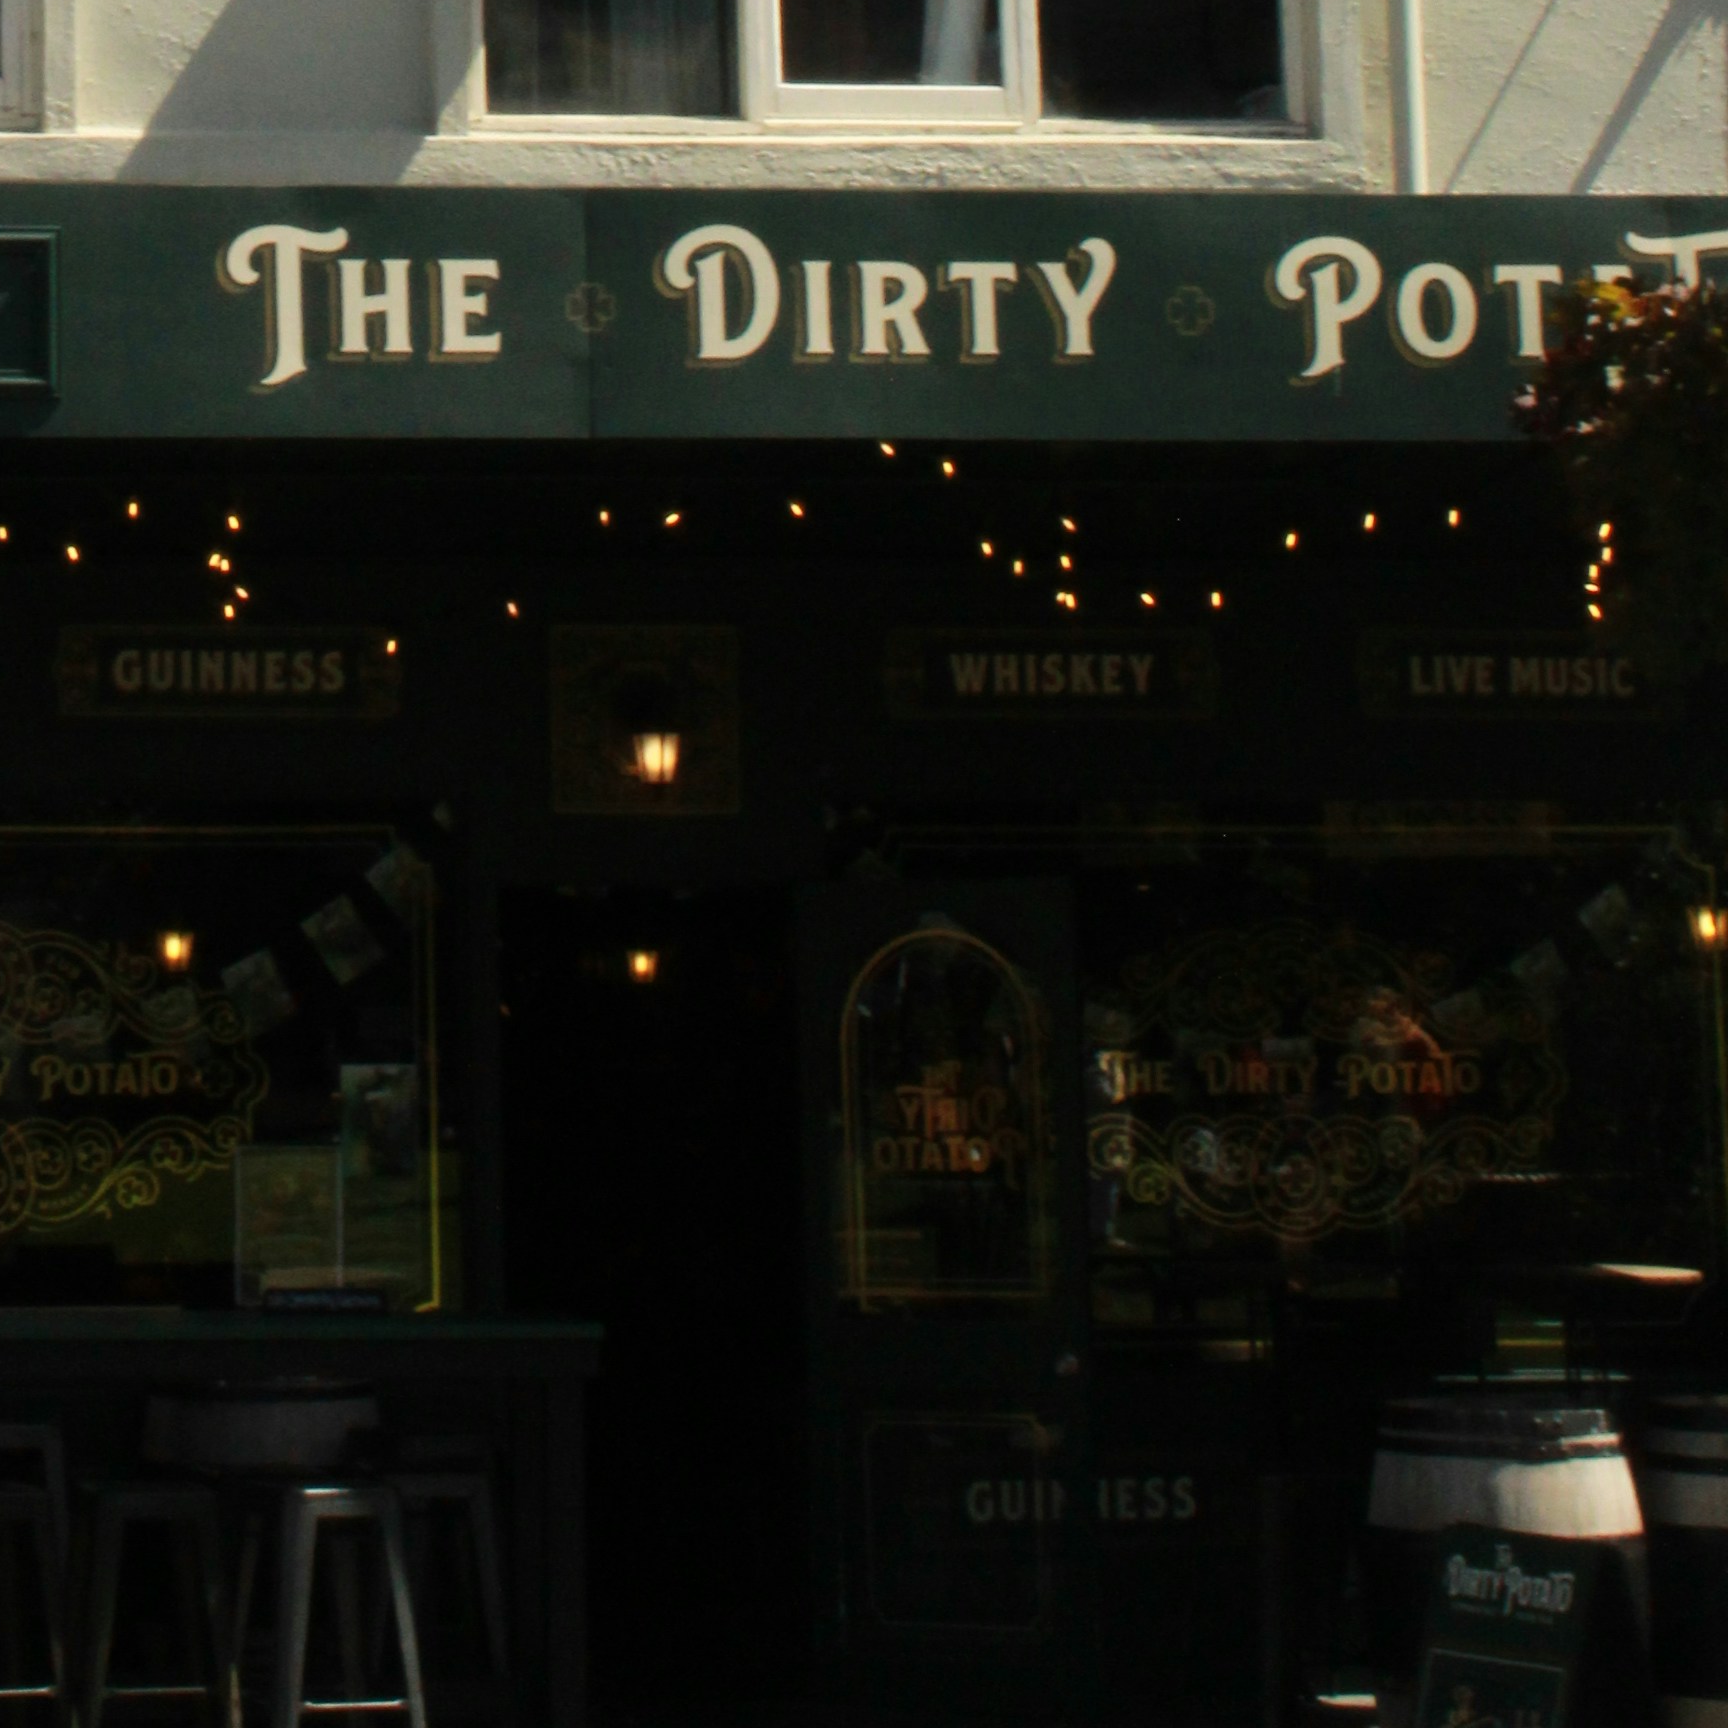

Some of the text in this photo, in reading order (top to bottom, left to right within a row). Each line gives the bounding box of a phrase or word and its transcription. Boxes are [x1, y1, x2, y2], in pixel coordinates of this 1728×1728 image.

[112, 649, 347, 693] GUINNESS
[948, 653, 1157, 697] WHISKEY
[1410, 655, 1636, 699] LIVE MUSIC
